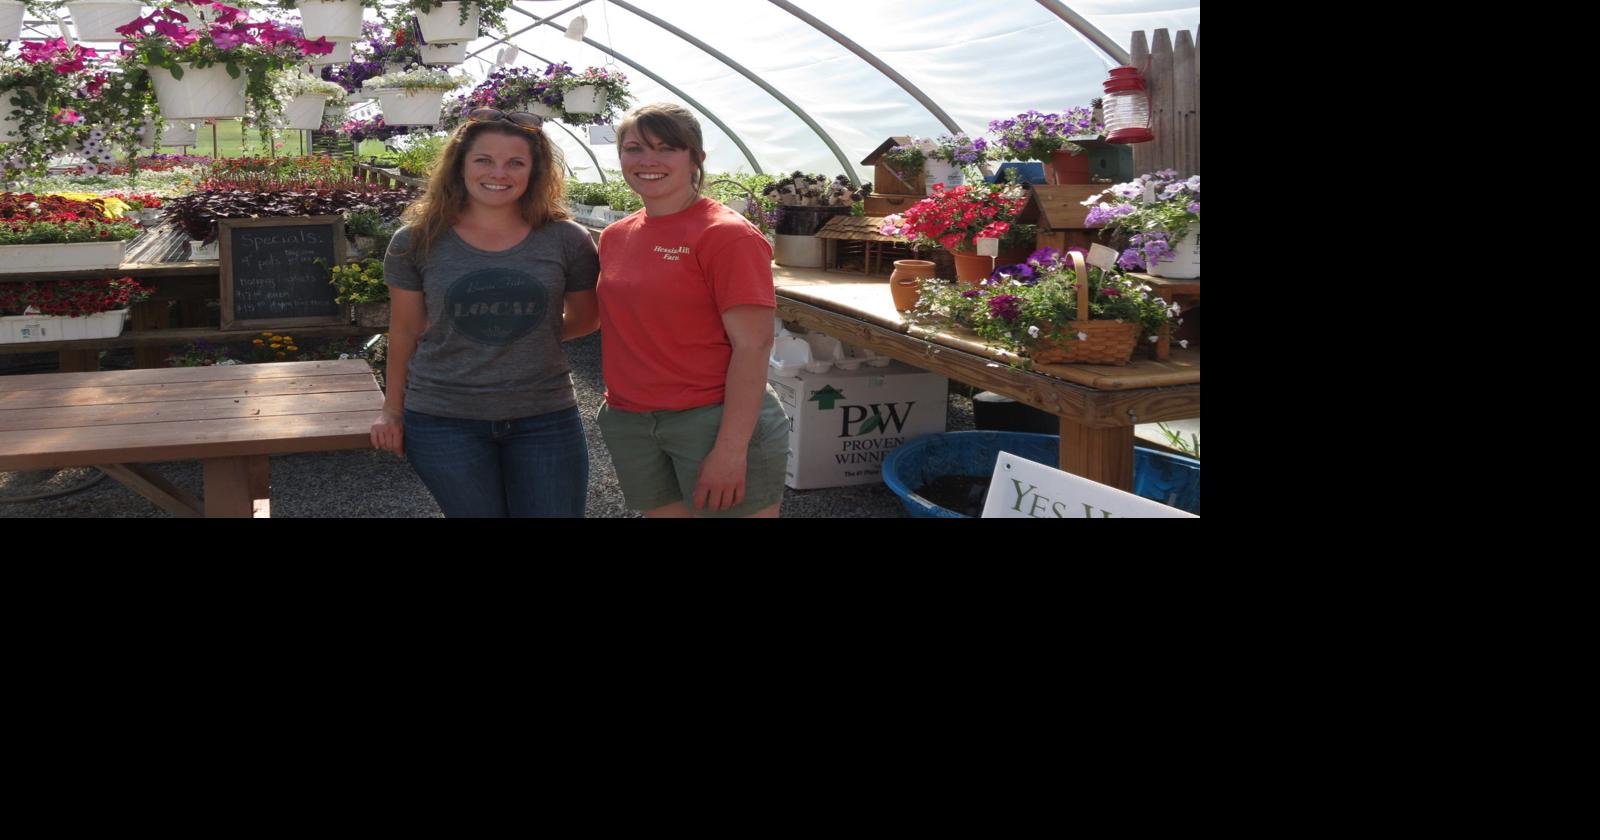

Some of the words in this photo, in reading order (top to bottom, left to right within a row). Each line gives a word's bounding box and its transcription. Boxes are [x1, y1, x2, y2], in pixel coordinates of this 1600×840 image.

[240, 230, 324, 251] Specials:
[454, 301, 540, 317] LOCAL
[837, 401, 917, 438] PW
[843, 437, 905, 451] PROVEN
[835, 450, 889, 465] WINNE
[1010, 478, 1067, 518] YES
